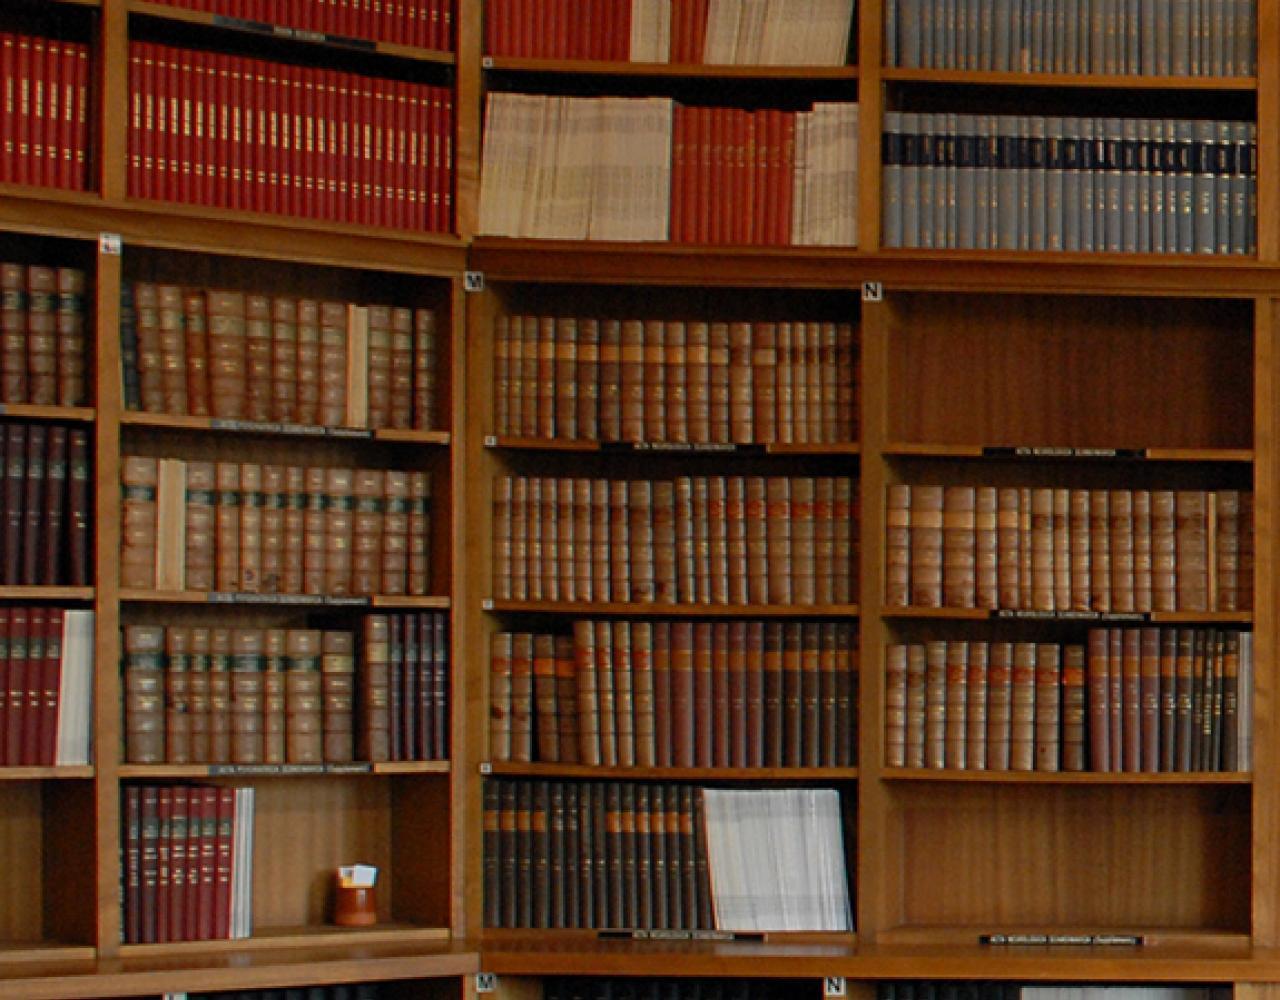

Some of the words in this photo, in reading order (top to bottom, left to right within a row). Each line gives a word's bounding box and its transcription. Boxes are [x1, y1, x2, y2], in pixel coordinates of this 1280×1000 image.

[466, 274, 482, 288] M
[866, 282, 879, 298] N
[478, 975, 494, 988] M
[828, 977, 842, 993] N
